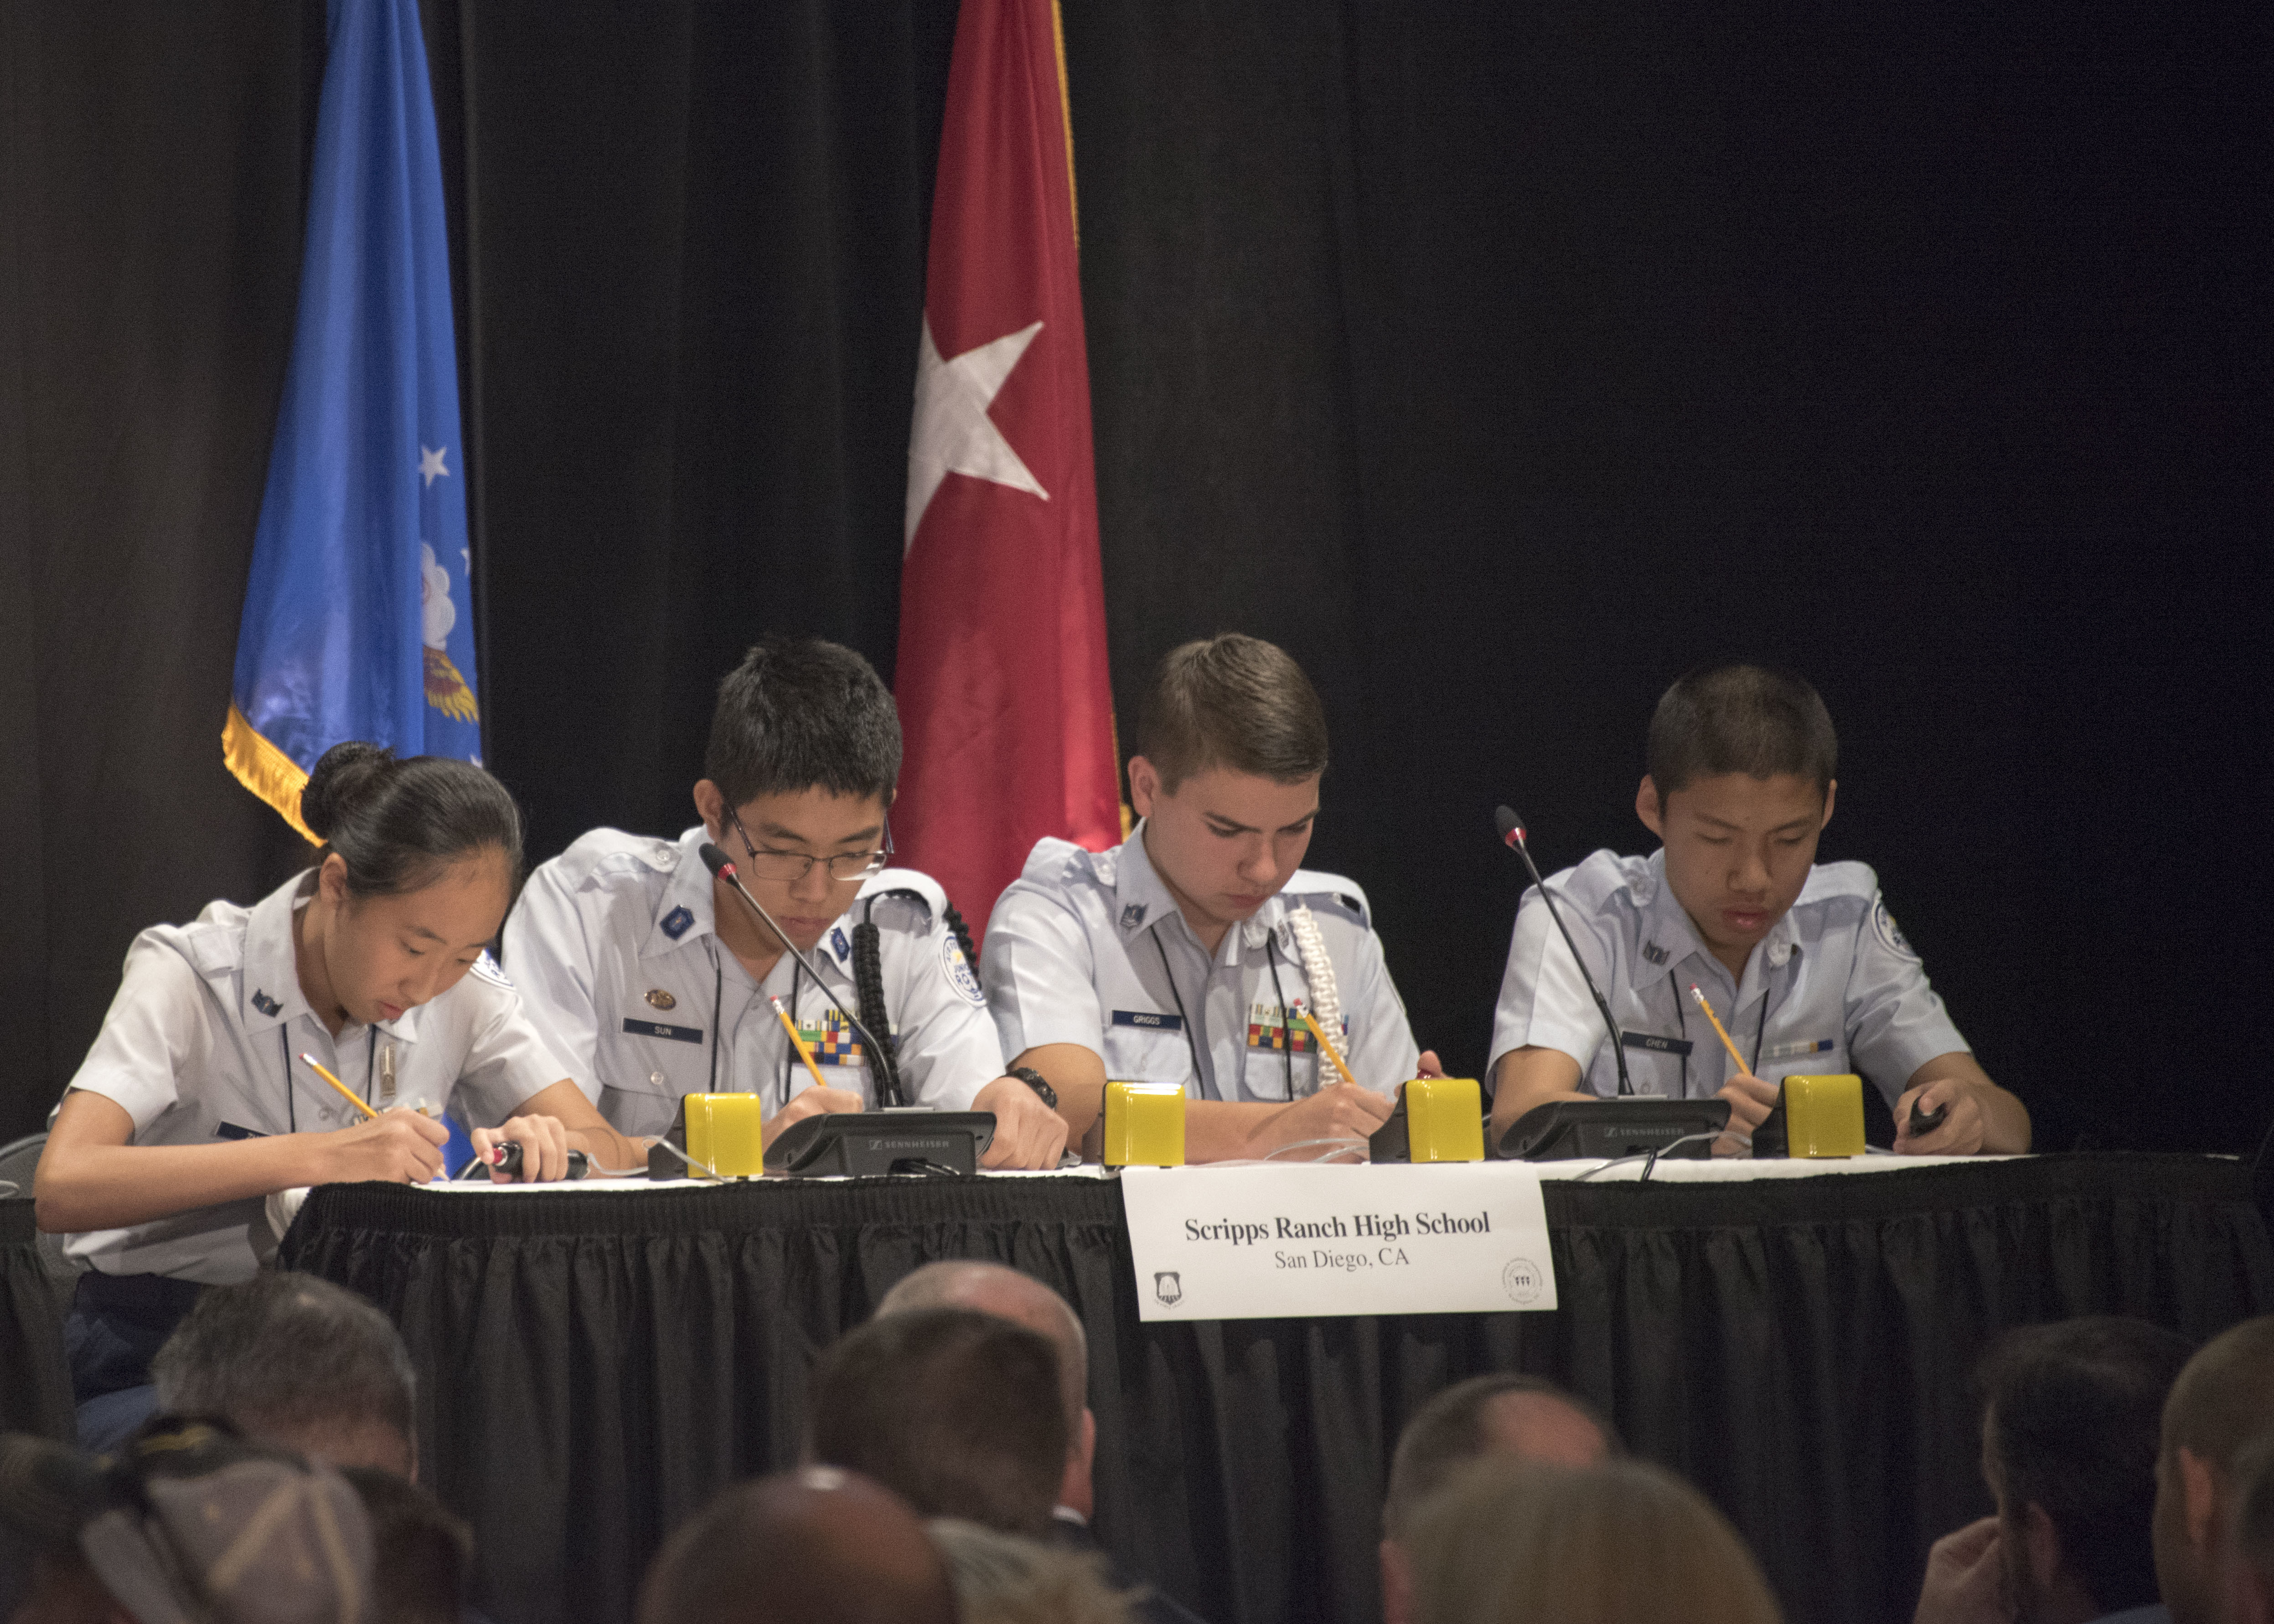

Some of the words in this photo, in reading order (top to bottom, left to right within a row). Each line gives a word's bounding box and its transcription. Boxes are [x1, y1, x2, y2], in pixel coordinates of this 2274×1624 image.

[1133, 1016, 1160, 1025] GRIGGS
[655, 1026, 672, 1036] SUN
[1645, 1038, 1668, 1049] CHEN
[1185, 1218, 1270, 1246] Scripps
[1276, 1216, 1348, 1239] Ranch
[1354, 1214, 1411, 1242] High
[1416, 1211, 1491, 1235] School
[1275, 1252, 1308, 1269] San
[1313, 1250, 1374, 1273] Diego,
[1378, 1248, 1410, 1266] CA
